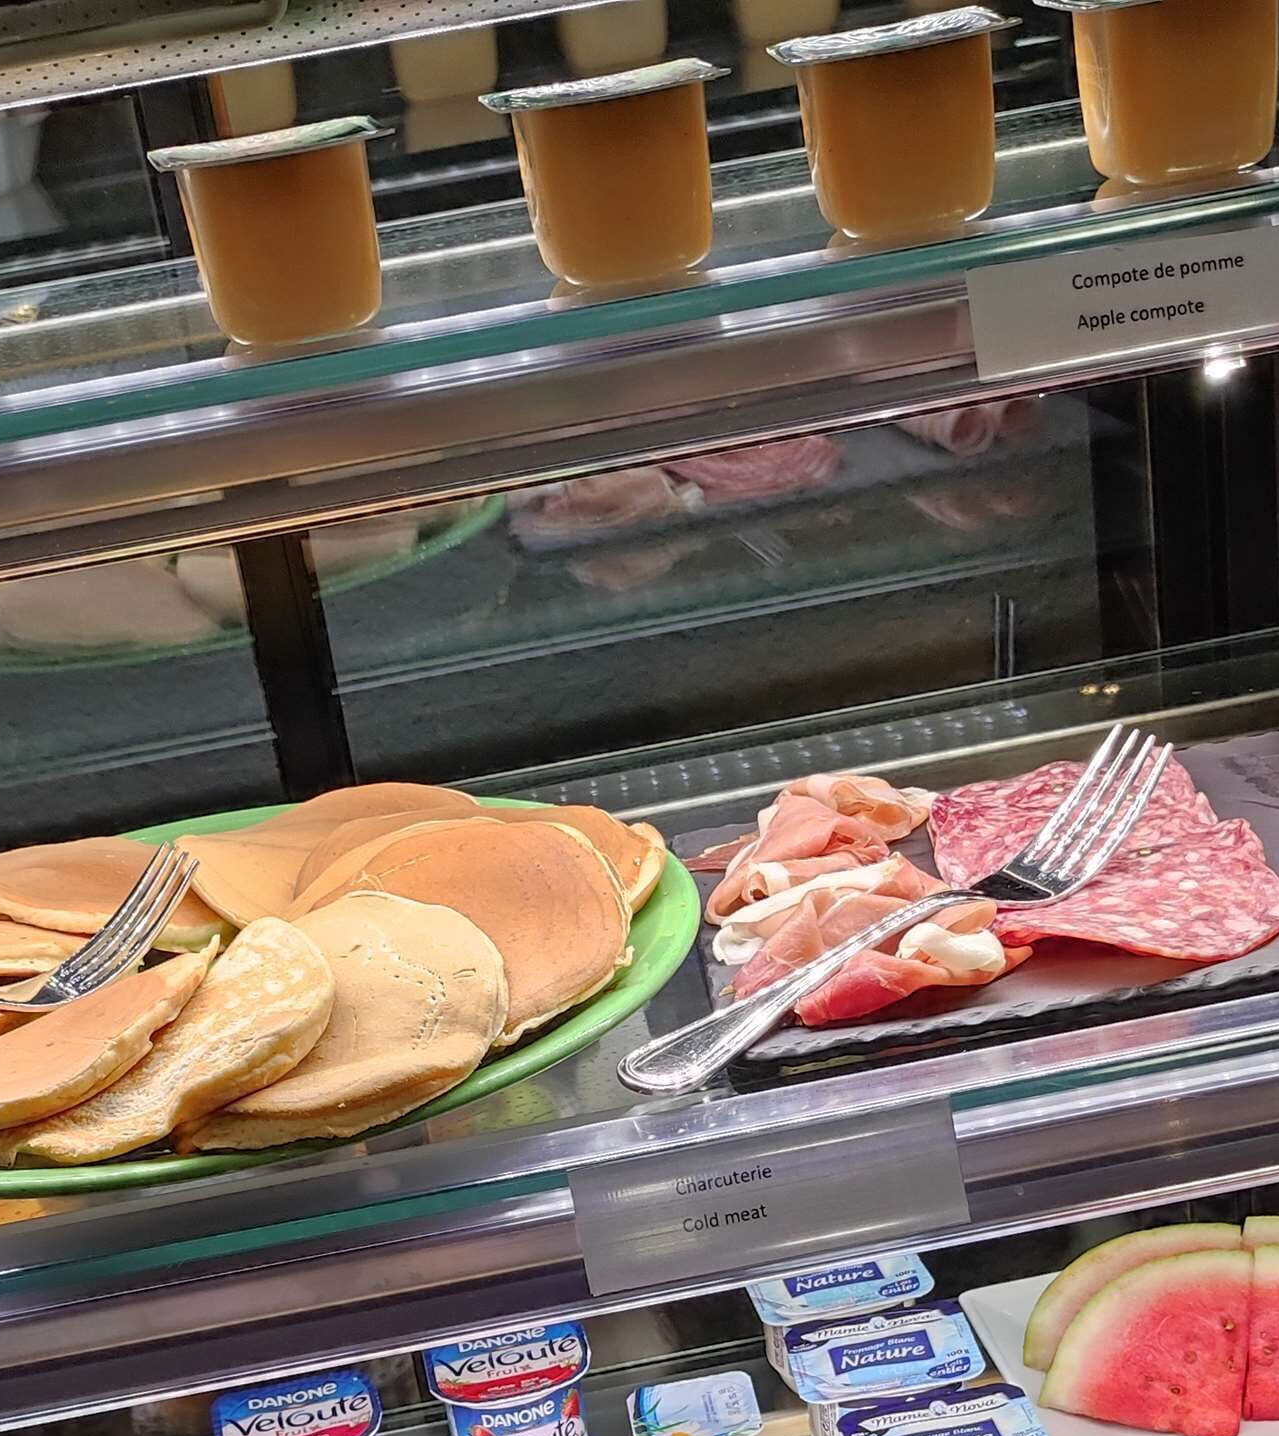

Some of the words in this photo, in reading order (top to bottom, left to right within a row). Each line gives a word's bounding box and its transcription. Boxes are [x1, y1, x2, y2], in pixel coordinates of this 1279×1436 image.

[1072, 268, 1149, 290] Compote
[1154, 262, 1175, 279] de
[1179, 254, 1245, 279] pomme
[1077, 311, 1125, 330] Apple
[1130, 299, 1205, 324] compote
[675, 1165, 772, 1196] Charcuterie
[682, 1213, 720, 1234] Cold
[725, 1204, 767, 1226] meat
[817, 1324, 869, 1338] Mamie
[888, 1312, 933, 1327] Nova
[434, 1333, 578, 1377] Velouté
[840, 1344, 926, 1370] Nature
[842, 1341, 885, 1355] Fromage
[888, 1335, 916, 1346] Blanc
[224, 1391, 369, 1436] Velouté
[871, 1411, 931, 1428] Mamie
[949, 1398, 996, 1414] Nova
[952, 1424, 982, 1436] Blanc
